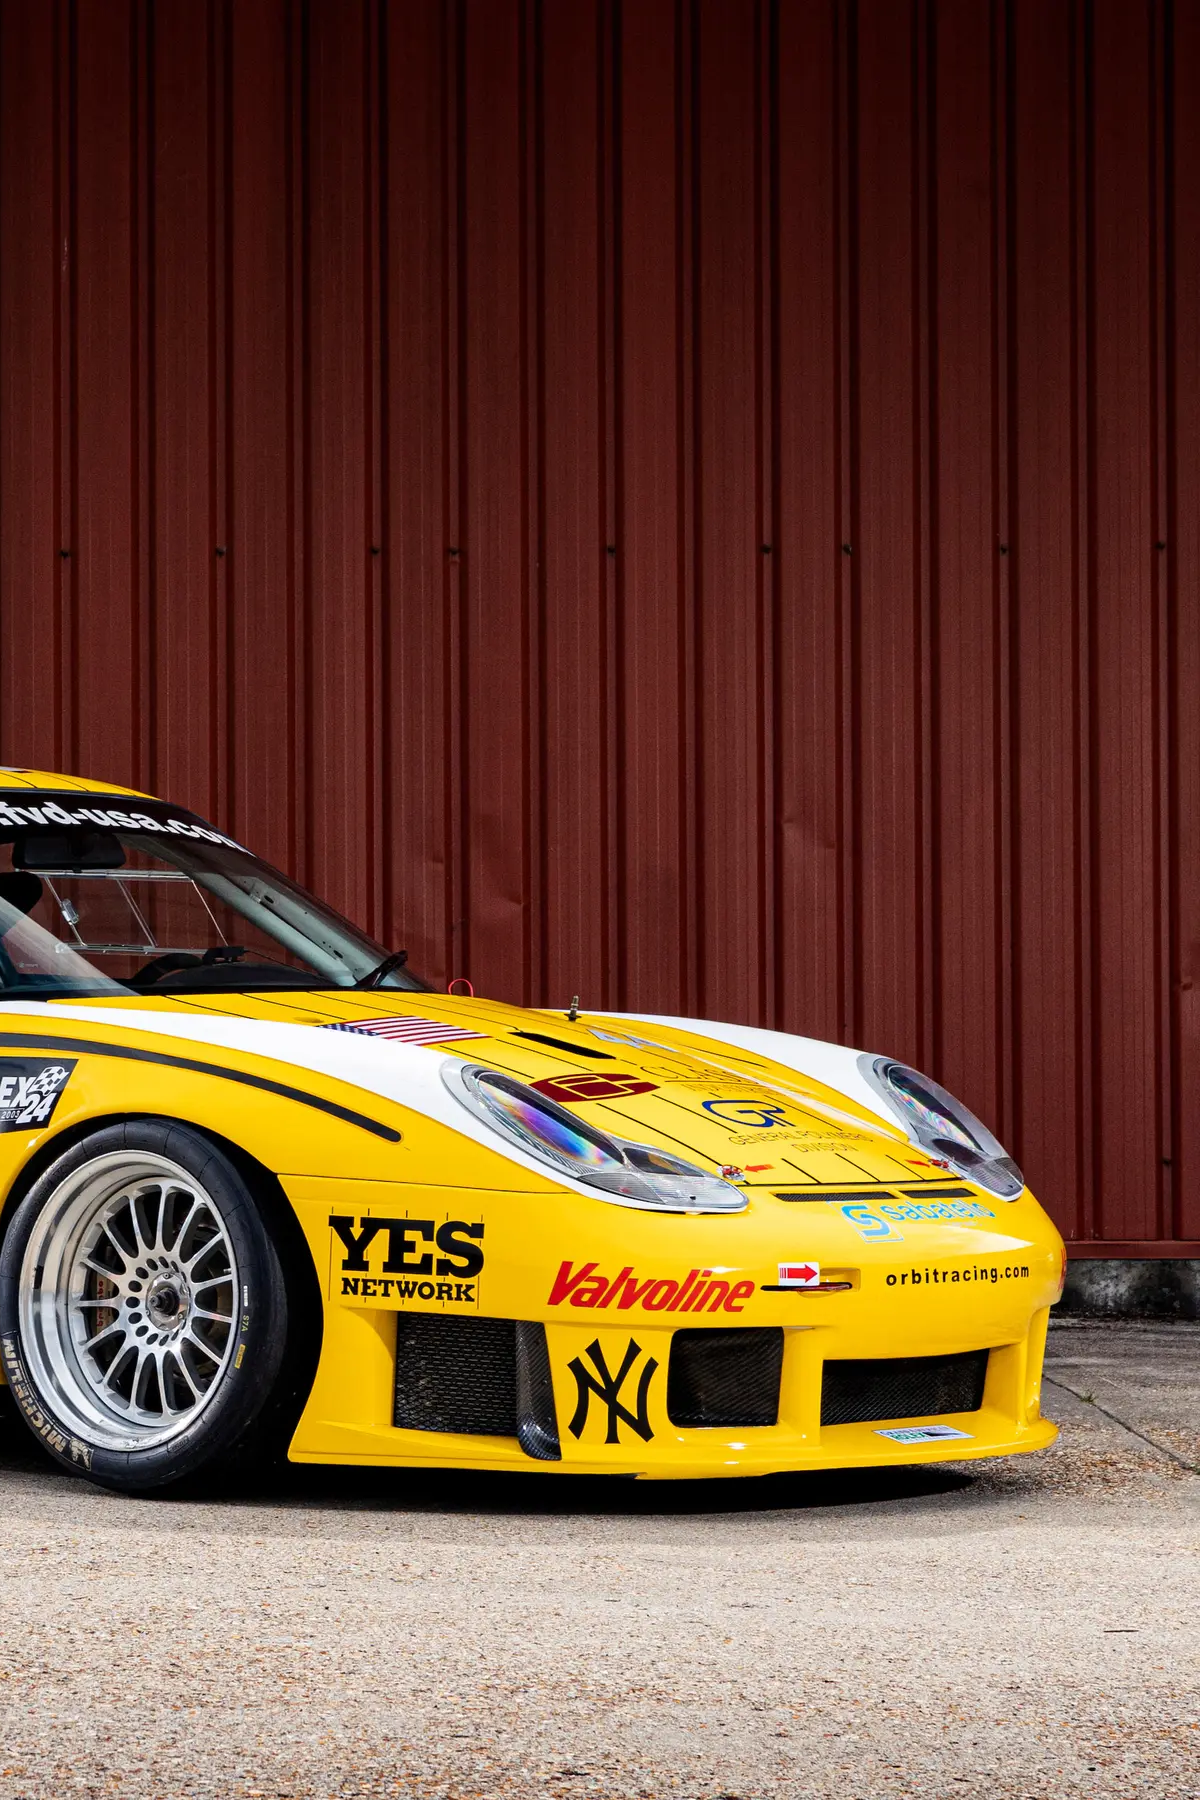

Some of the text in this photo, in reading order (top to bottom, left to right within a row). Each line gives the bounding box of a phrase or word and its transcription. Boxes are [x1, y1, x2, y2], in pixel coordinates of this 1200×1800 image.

[1, 1110, 21, 1119] 2003
[15, 1092, 57, 1124] 24
[328, 1215, 485, 1279] YES
[341, 1277, 476, 1303] NETWORK
[547, 1261, 755, 1313] Valvoline
[885, 1265, 1030, 1286] orbitracing.com
[241, 1314, 250, 1332] S7A
[0, 1339, 67, 1453] MICHELIN
[567, 1337, 659, 1444] NY
